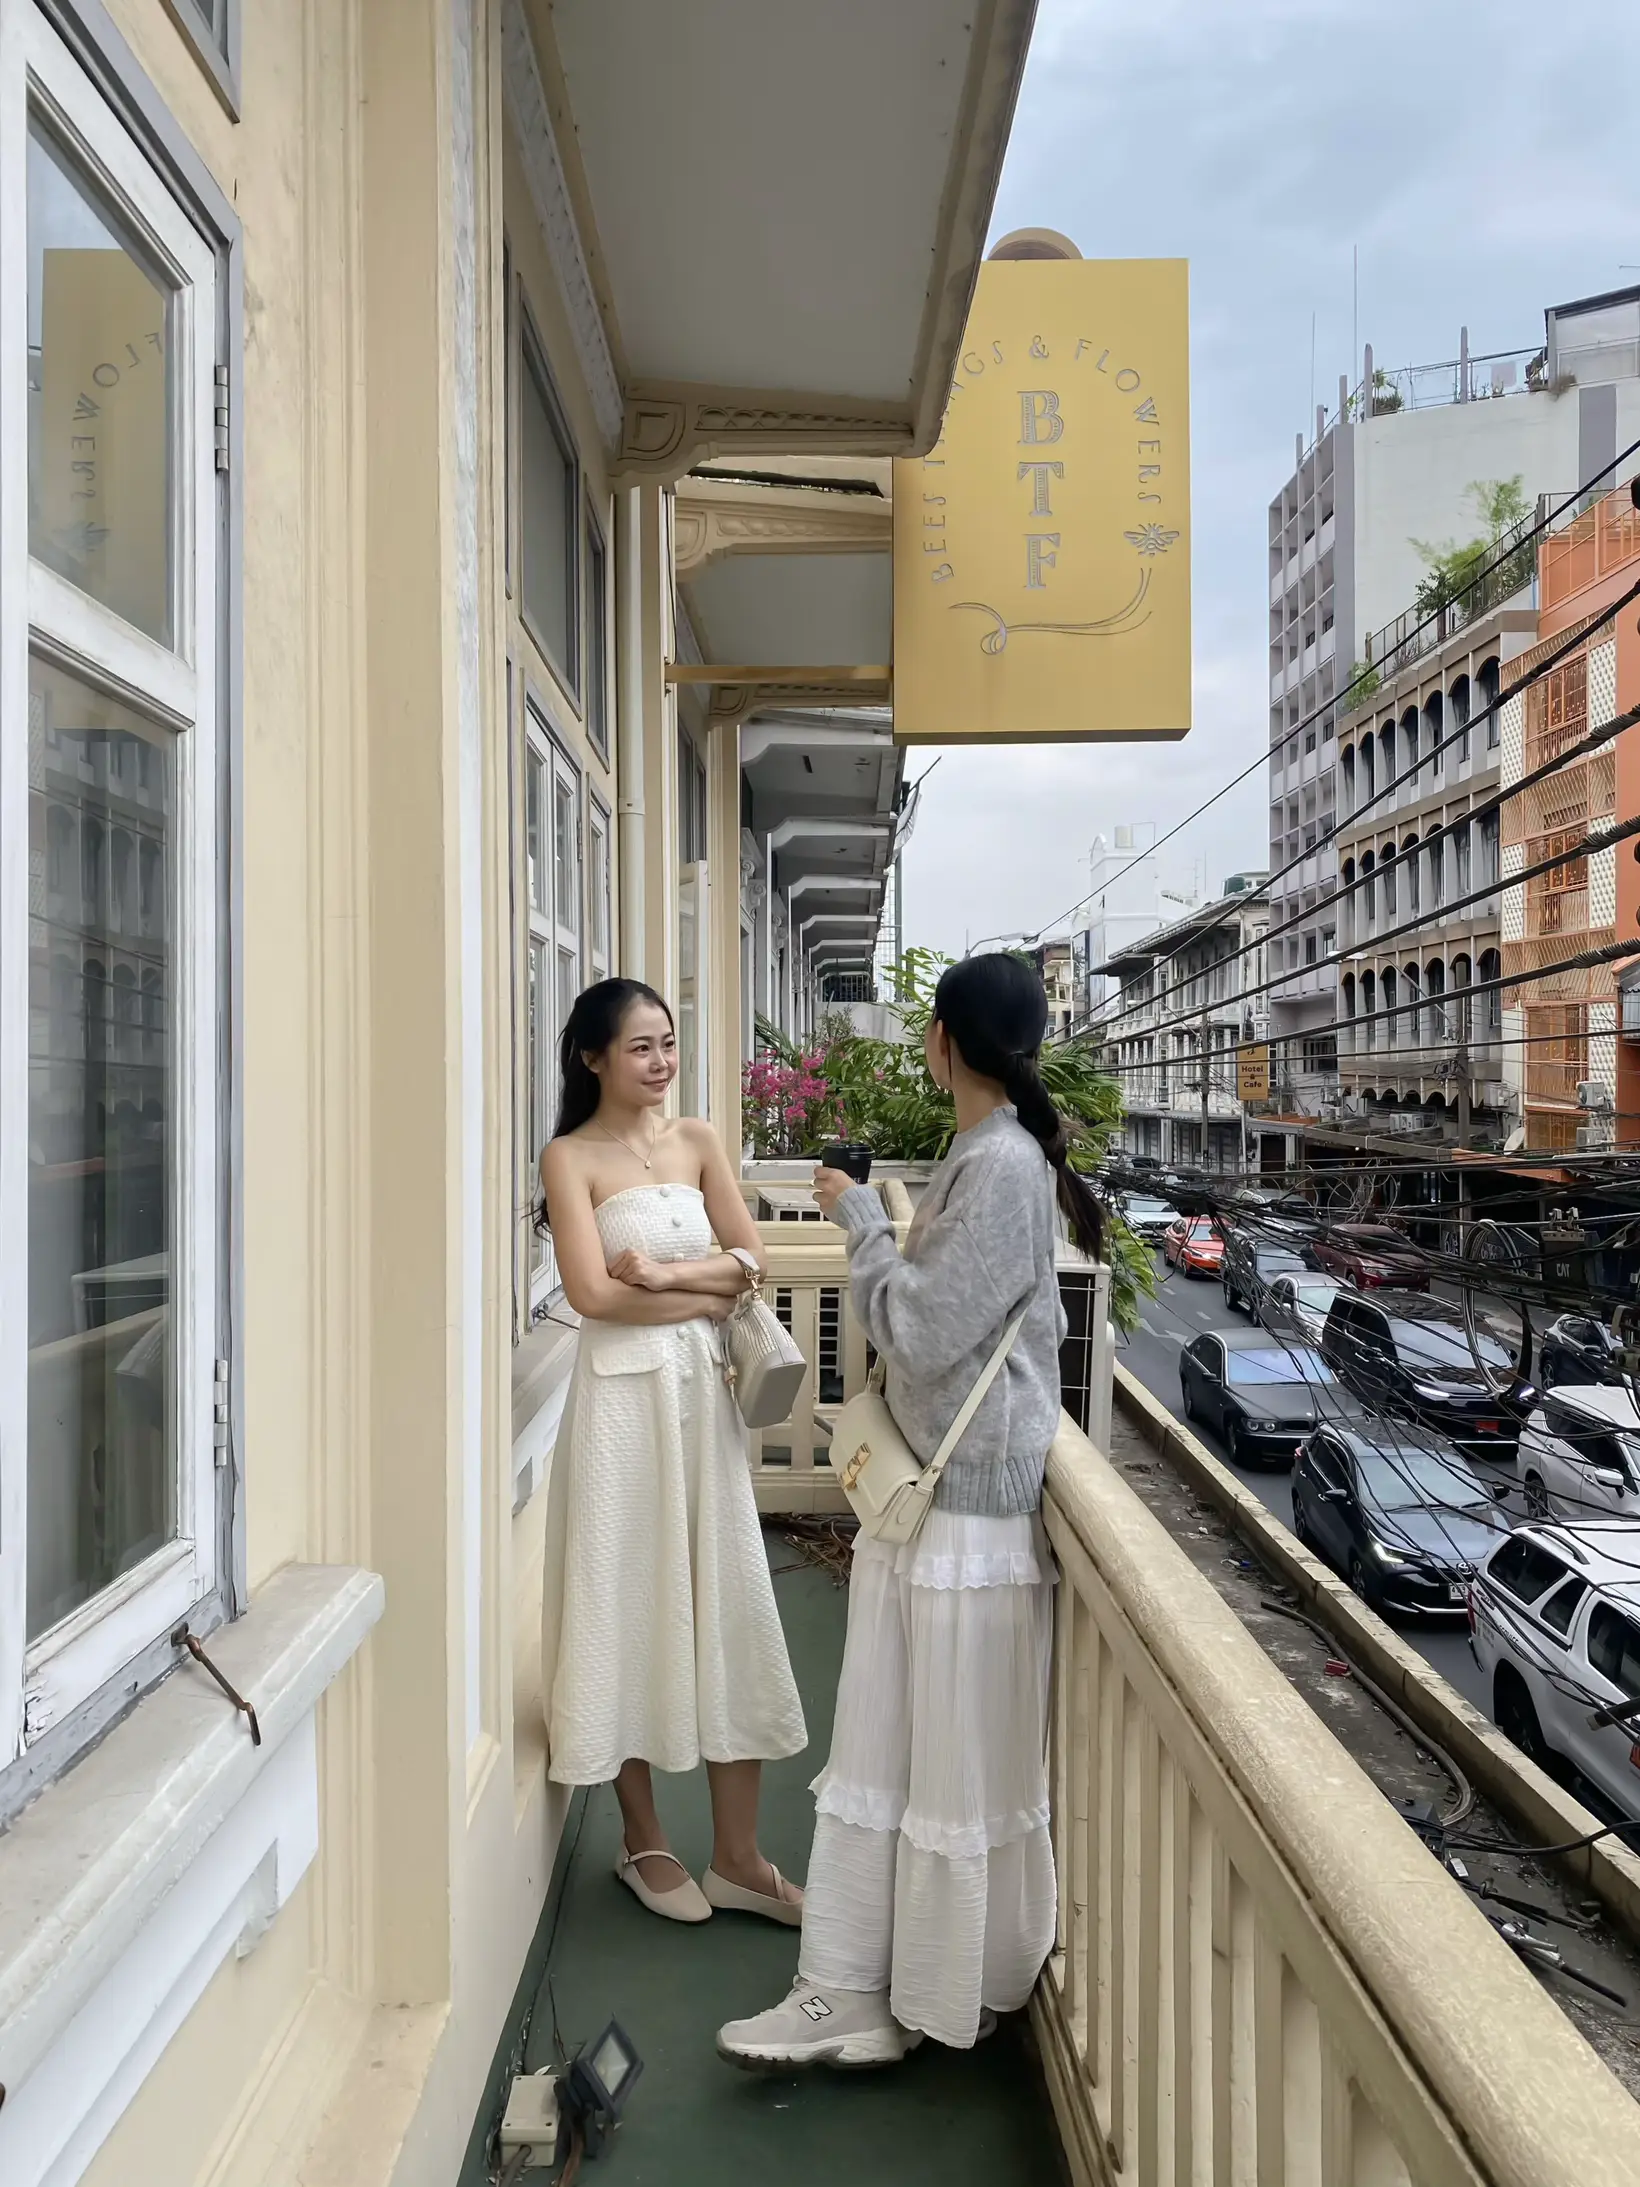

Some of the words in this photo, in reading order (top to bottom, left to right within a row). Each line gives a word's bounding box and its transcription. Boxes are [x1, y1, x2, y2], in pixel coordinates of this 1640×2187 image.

[1028, 334, 1050, 360] &
[922, 340, 1004, 471] TGS
[1074, 338, 1162, 505] FLOWERS
[922, 493, 955, 584] BEES
[1241, 1065, 1264, 1073] Hotel
[1556, 1262, 1571, 1278] CAT
[800, 1996, 832, 2021] N
